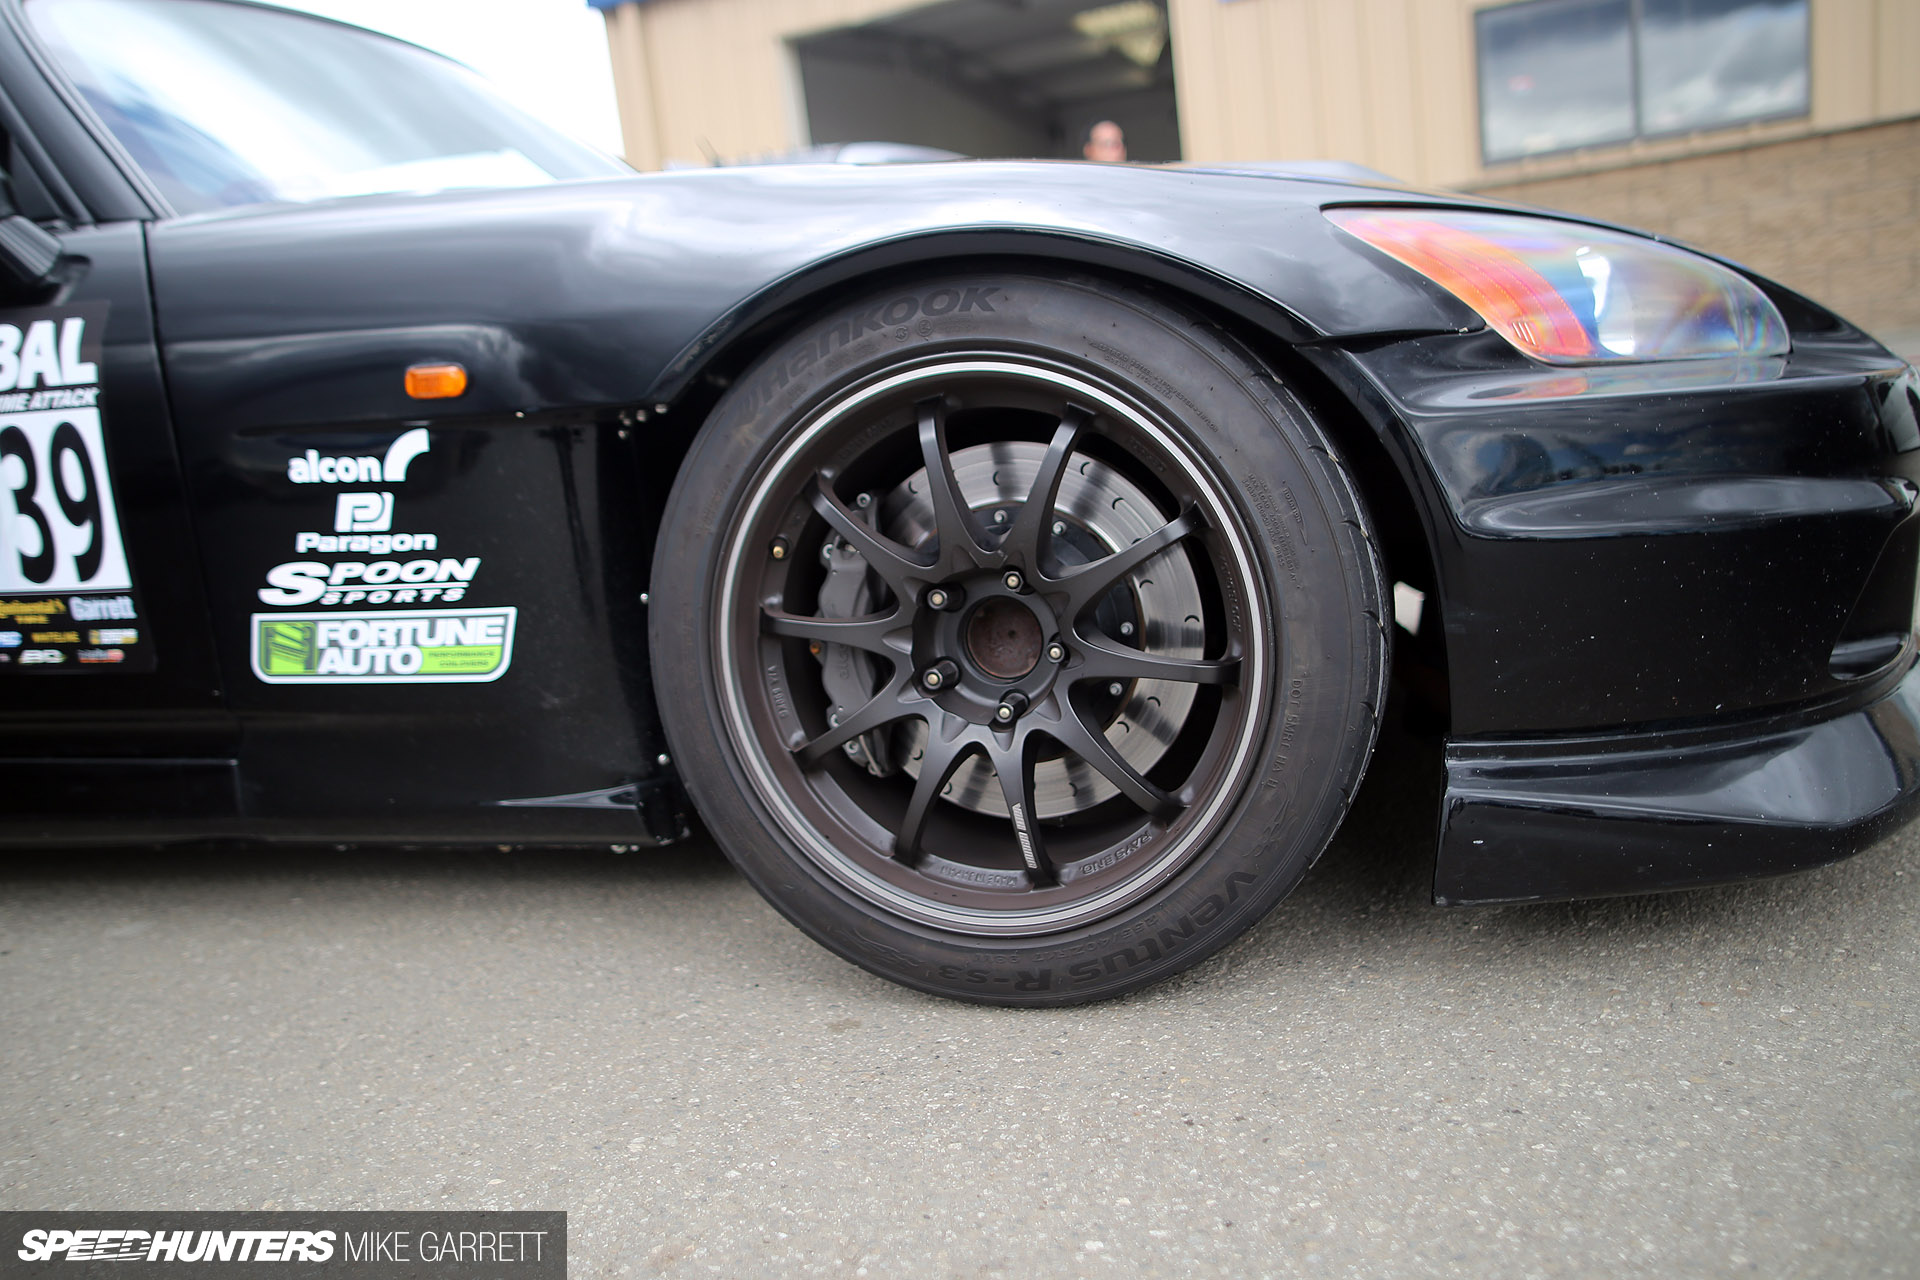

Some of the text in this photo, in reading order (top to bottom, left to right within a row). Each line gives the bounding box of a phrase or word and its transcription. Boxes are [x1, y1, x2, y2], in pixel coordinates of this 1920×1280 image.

[0, 316, 99, 392] BAL
[28, 387, 100, 410] ATTACK
[288, 448, 382, 484] alcon
[0, 421, 104, 584] 39
[1281, 487, 1302, 522] ROTATION
[295, 532, 438, 554] Paragon
[257, 557, 482, 606] SPOON
[318, 587, 466, 605] SPORTS
[316, 616, 505, 648] FORTUNE
[315, 646, 423, 675] AUTO
[1290, 678, 1303, 706] DOT
[1114, 830, 1153, 862] RAYS
[987, 873, 1018, 888] MADE
